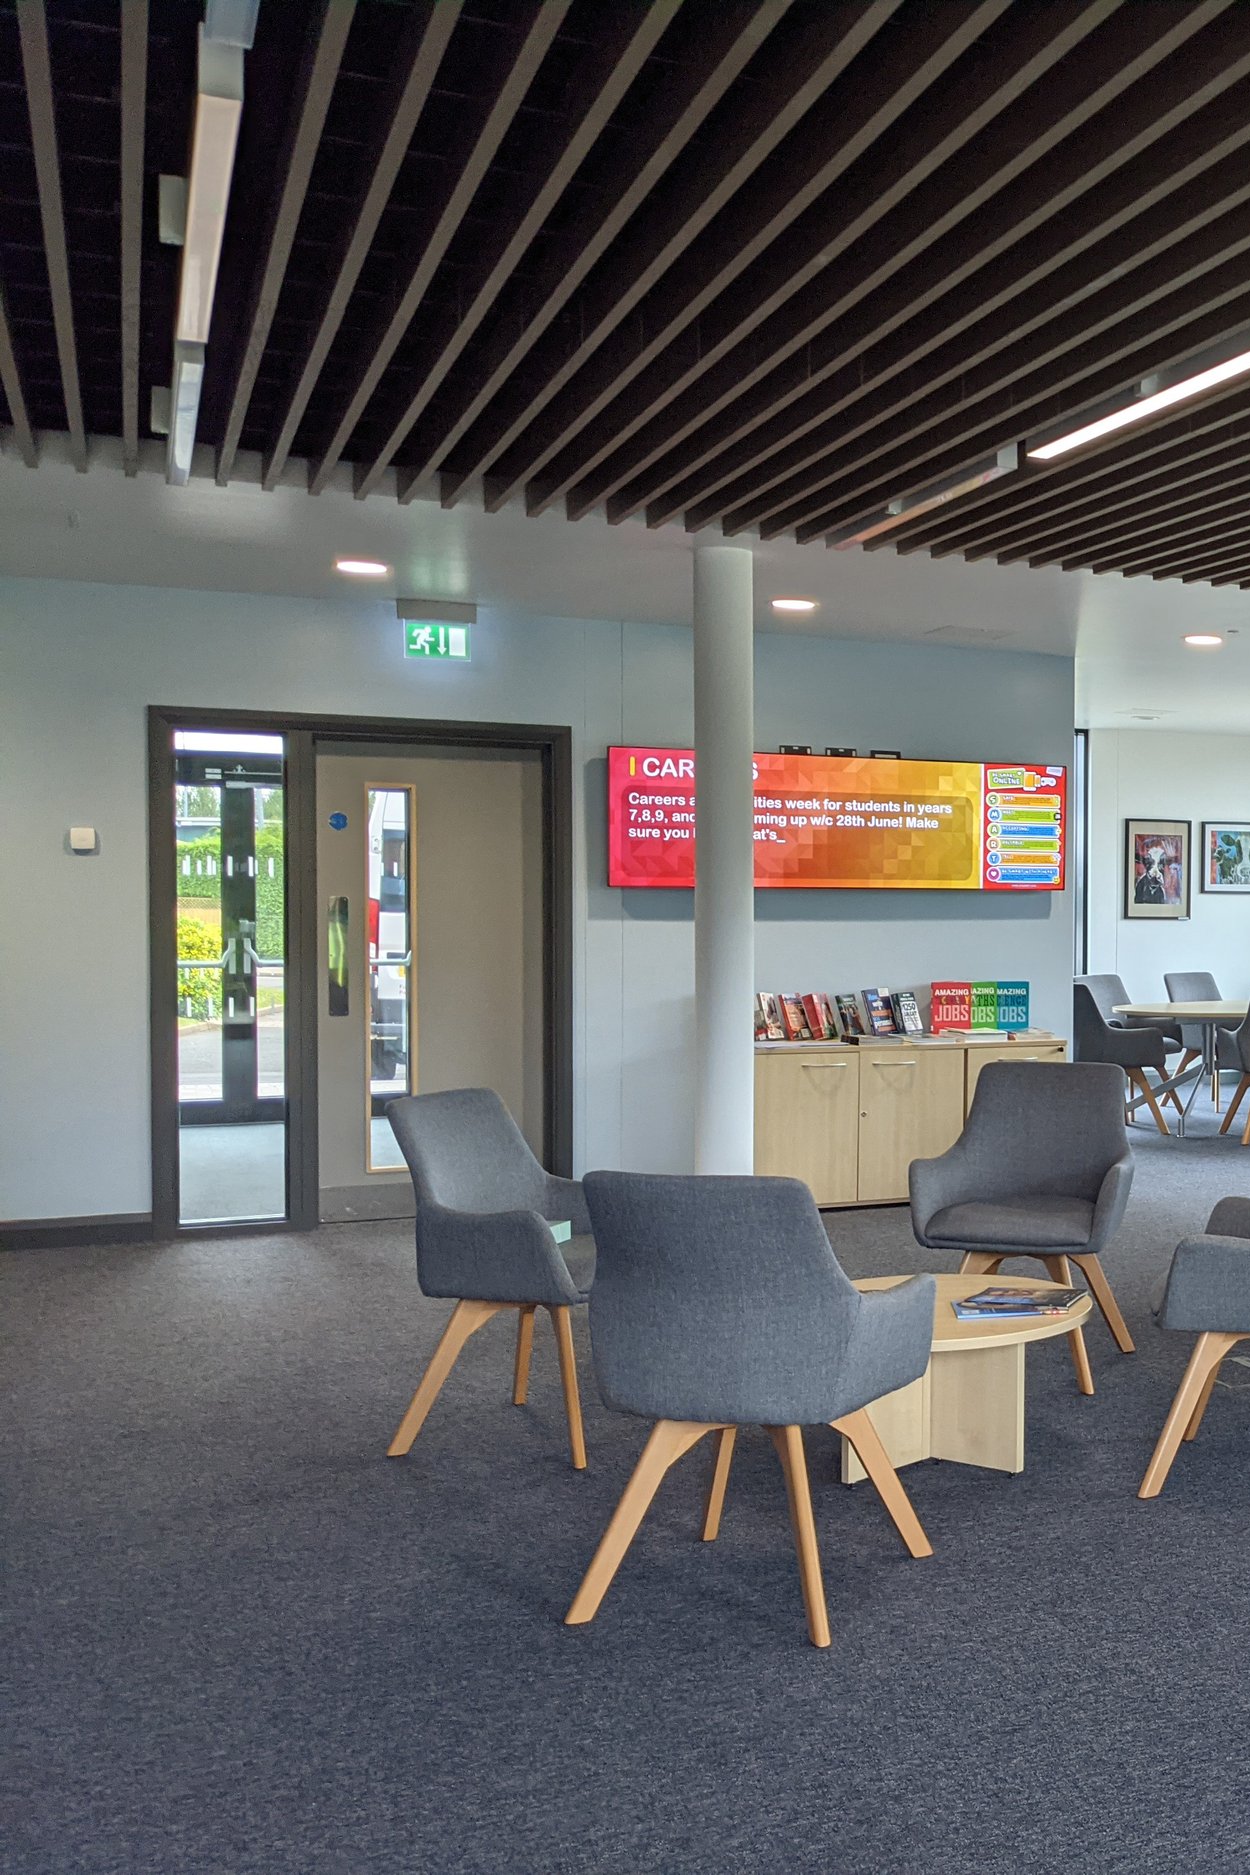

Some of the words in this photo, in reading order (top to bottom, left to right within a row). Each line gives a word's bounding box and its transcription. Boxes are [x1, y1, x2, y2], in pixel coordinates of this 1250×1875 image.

[628, 792, 686, 806] Careers
[785, 798, 820, 810] week
[823, 798, 842, 811] for
[845, 799, 900, 812] students
[904, 802, 915, 812] in
[917, 804, 952, 816] years
[629, 809, 668, 824] 7,8,9,
[753, 813, 787, 827] ming
[790, 816, 807, 827] up
[810, 815, 833, 826] w/c
[836, 815, 865, 827] 28th
[868, 816, 903, 828] June!
[906, 817, 939, 829] Make
[628, 827, 661, 838] sure
[664, 829, 689, 841] you
[934, 988, 969, 996] AMAZING
[971, 987, 994, 995] AZING
[972, 995, 995, 1006] ATHS
[934, 1005, 969, 1021] JOBS
[971, 1006, 994, 1022] OBS
[1000, 1006, 1026, 1022] OBS
